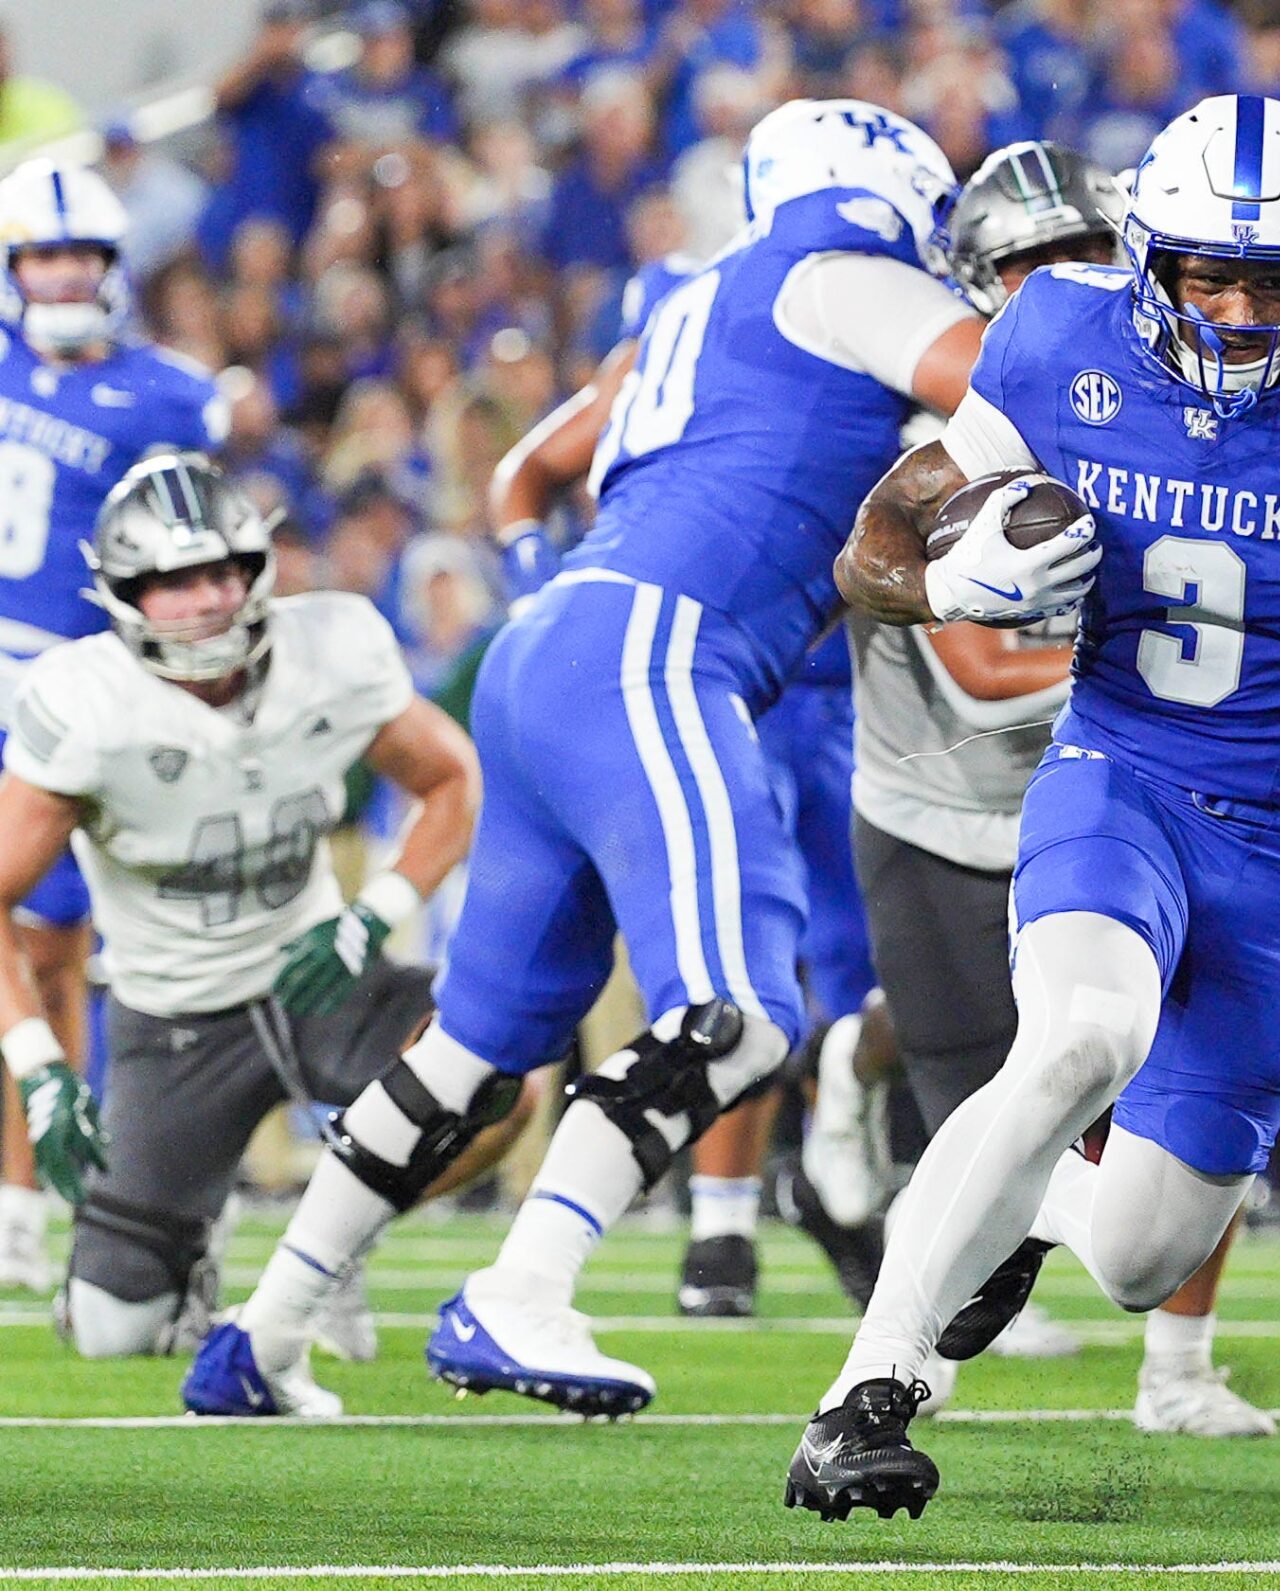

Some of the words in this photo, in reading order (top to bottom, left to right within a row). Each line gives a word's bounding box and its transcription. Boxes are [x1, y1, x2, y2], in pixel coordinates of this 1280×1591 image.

[1073, 373, 1118, 422] SEC
[1183, 406, 1219, 441] UK
[1136, 534, 1247, 709] 3
